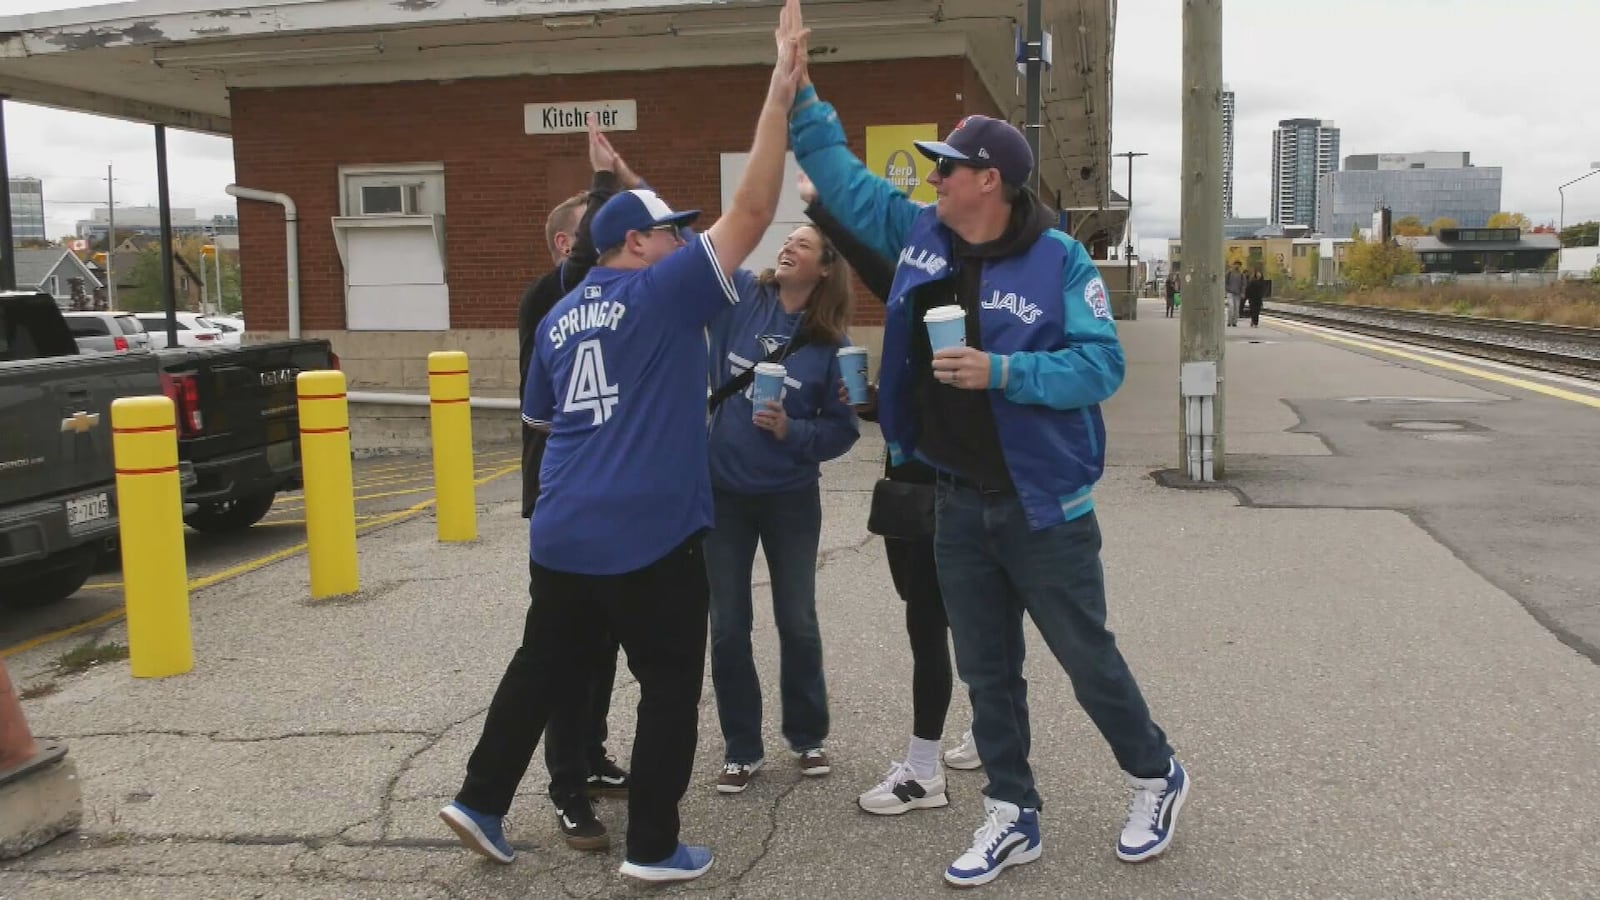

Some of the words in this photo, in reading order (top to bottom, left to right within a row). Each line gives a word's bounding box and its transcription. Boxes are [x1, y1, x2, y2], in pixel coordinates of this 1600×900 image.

[888, 164, 913, 176] Zero
[898, 245, 947, 276] LUE
[981, 290, 1043, 324] JAYS
[549, 301, 626, 349] SPRINGR
[563, 339, 619, 425] 4
